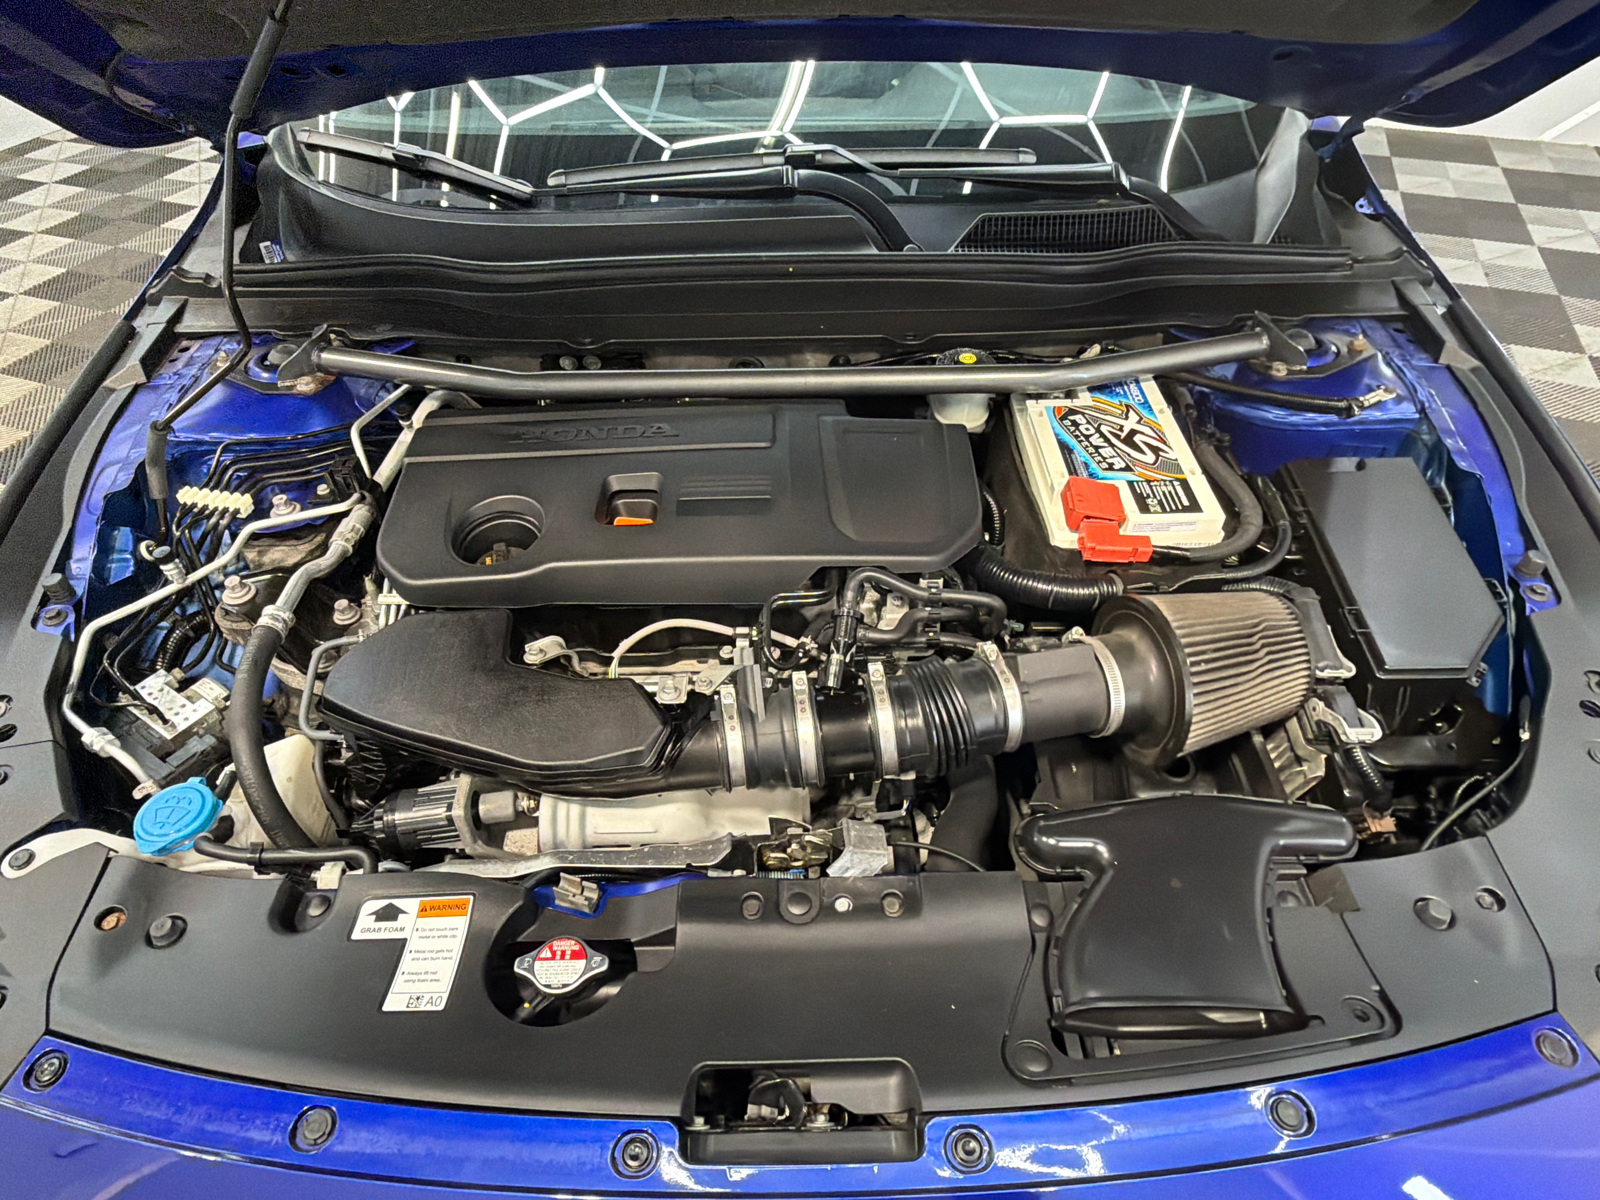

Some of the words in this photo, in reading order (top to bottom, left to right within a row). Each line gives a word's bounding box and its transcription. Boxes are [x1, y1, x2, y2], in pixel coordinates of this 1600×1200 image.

[508, 423, 680, 443] HONDA
[1067, 403, 1179, 465] XS
[1067, 414, 1128, 470] POWER
[1062, 419, 1110, 470] BATTERIES
[429, 903, 467, 912] WARNING
[360, 926, 382, 934] GRAB
[383, 926, 406, 934] FOAM
[424, 996, 443, 1007] A0
